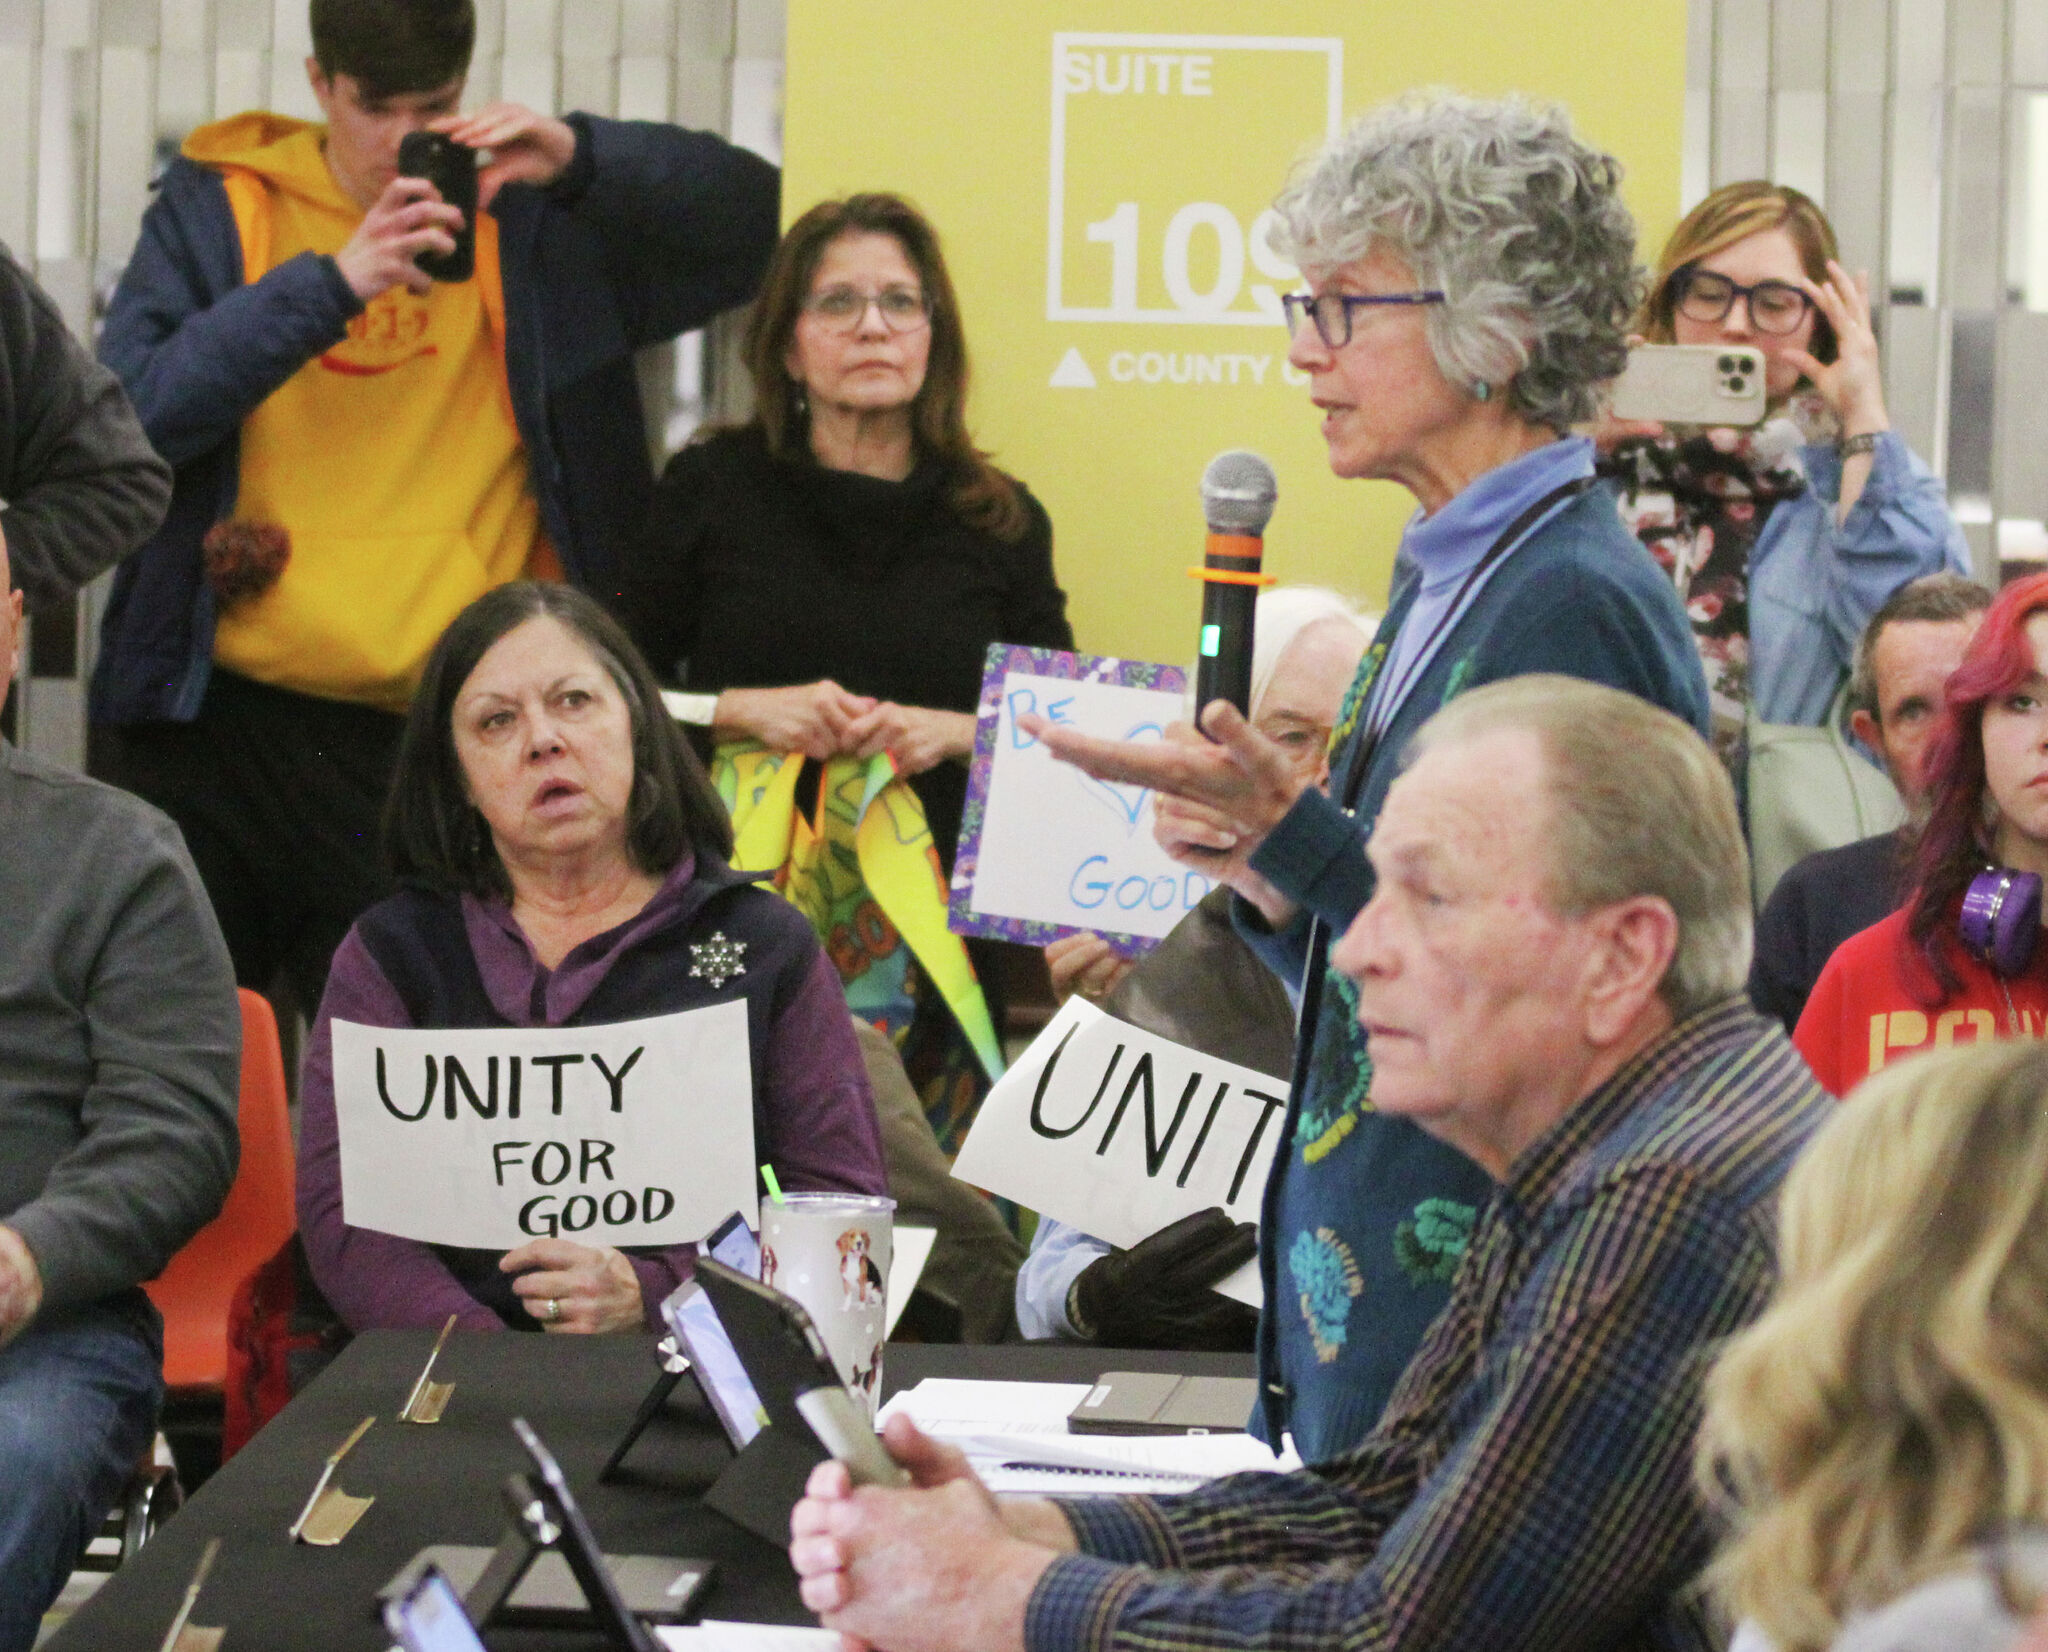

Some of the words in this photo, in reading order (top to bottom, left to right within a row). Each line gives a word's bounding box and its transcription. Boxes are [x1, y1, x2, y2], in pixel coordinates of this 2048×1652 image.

[1064, 53, 1213, 96] SUITE
[1108, 351, 1271, 385] COUNTY
[1007, 689, 1075, 749] BE
[1069, 855, 1210, 911] GOOD
[376, 1046, 645, 1122] UNITY
[493, 1138, 616, 1186] FOR
[517, 1186, 675, 1238] GOOD
